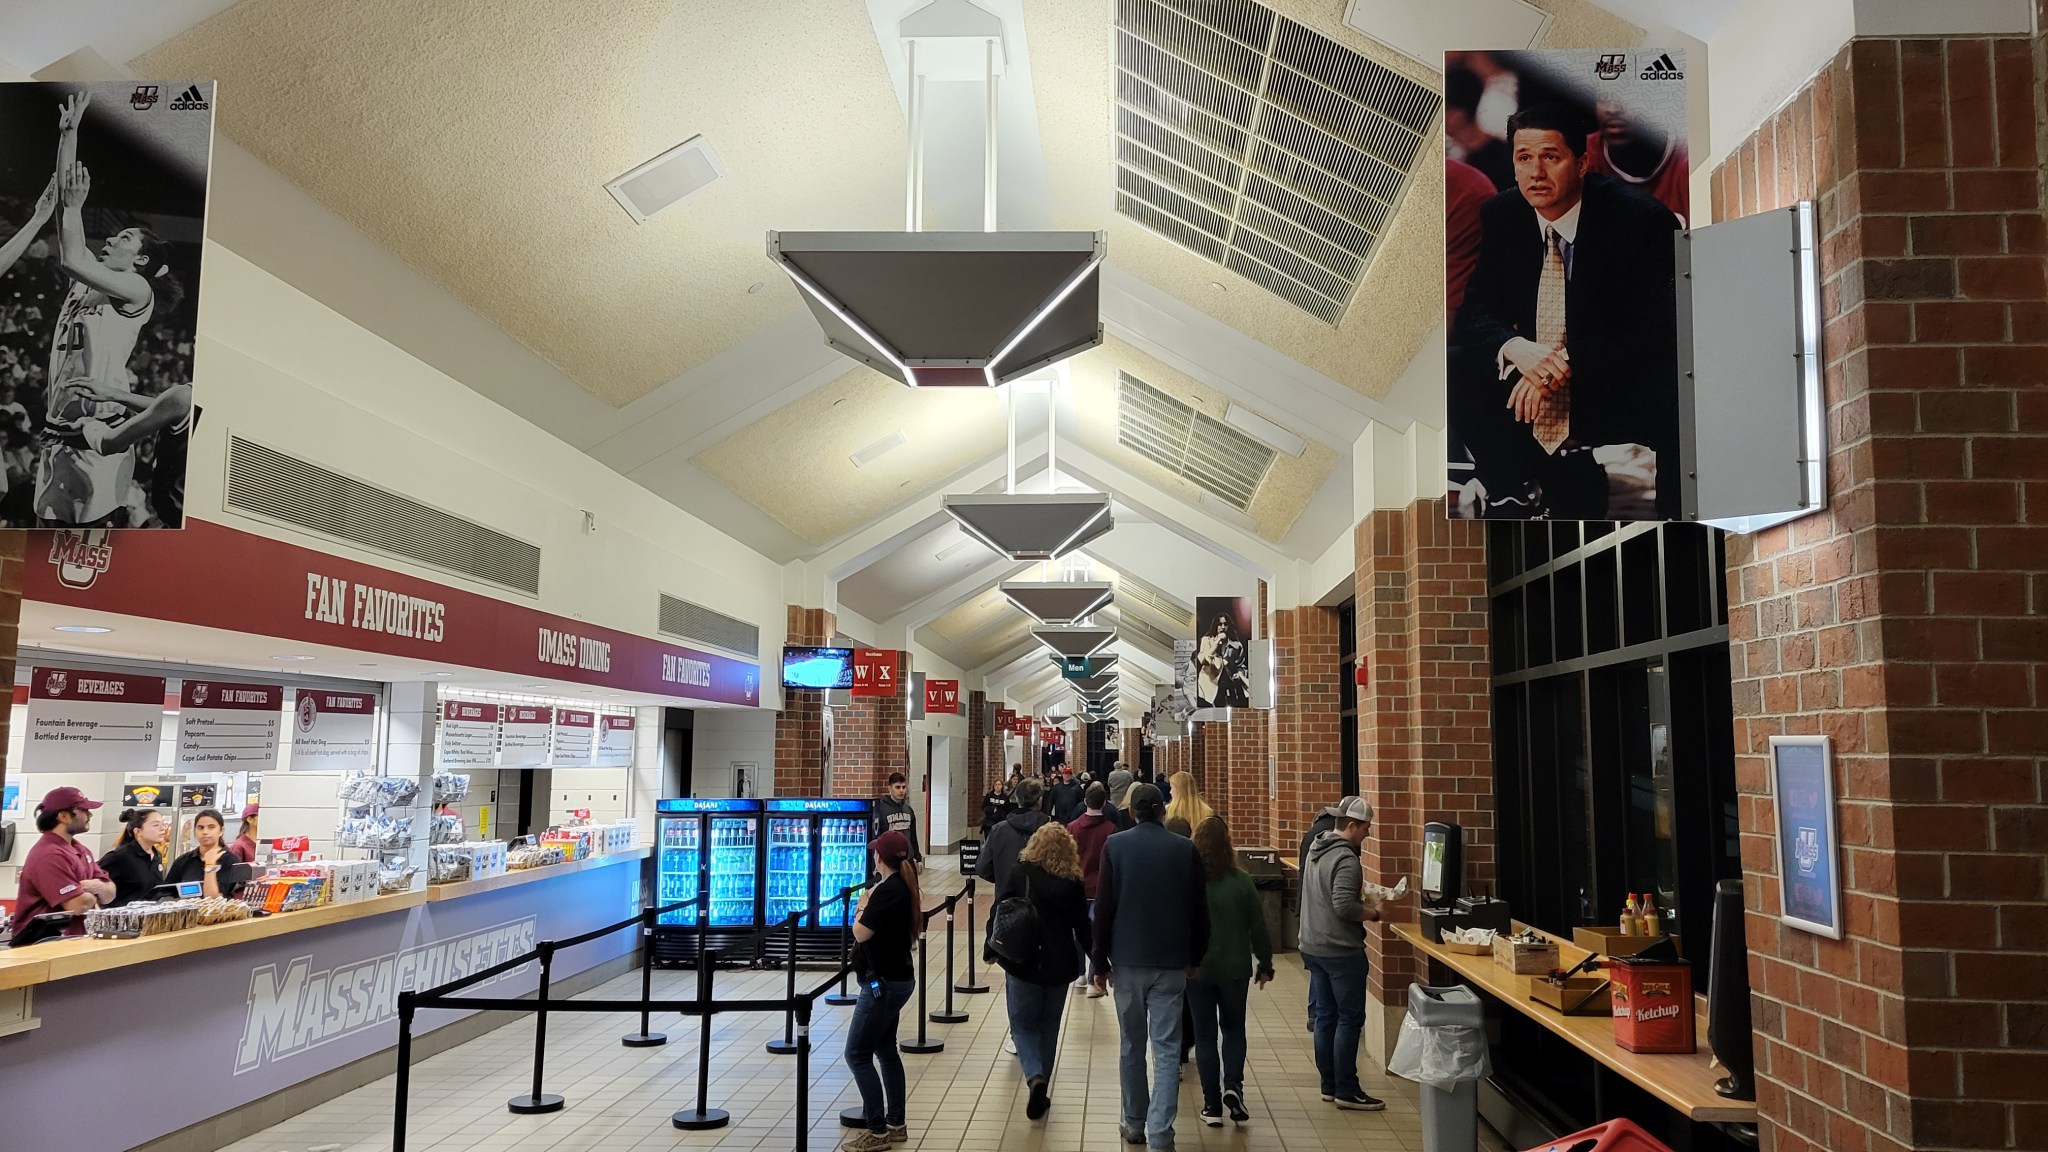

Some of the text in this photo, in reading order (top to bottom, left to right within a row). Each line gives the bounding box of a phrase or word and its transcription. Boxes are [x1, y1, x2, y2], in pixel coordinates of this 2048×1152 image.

[1640, 70, 1684, 80] adidas
[169, 101, 209, 111] adidas
[57, 322, 84, 351] 20
[305, 572, 445, 643] FAN FAVORITES
[538, 627, 611, 673] UMASS DINING
[662, 654, 676, 683] FAN
[677, 658, 711, 688] FAVORITES
[854, 665, 891, 680] W X
[1068, 663, 1084, 672] Men
[77, 679, 125, 695] BEVERAGES
[221, 689, 268, 704] FAN FAVORITES
[928, 690, 956, 702] V W
[325, 696, 363, 709] FAN FAVORITES
[36, 718, 153, 729] Fountain Beverage $3
[185, 717, 196, 725] Soft
[196, 718, 215, 726] Pretzel
[34, 732, 152, 742] Bottled Beverage $3
[184, 730, 206, 739] Popcorn
[183, 742, 199, 751] Candy
[223, 753, 237, 762] Chips
[694, 801, 718, 811] DASANI
[805, 801, 829, 810] DASANI
[236, 917, 536, 1072] MASSACHUSETTS
[1635, 1004, 1680, 1022] Ketchup
